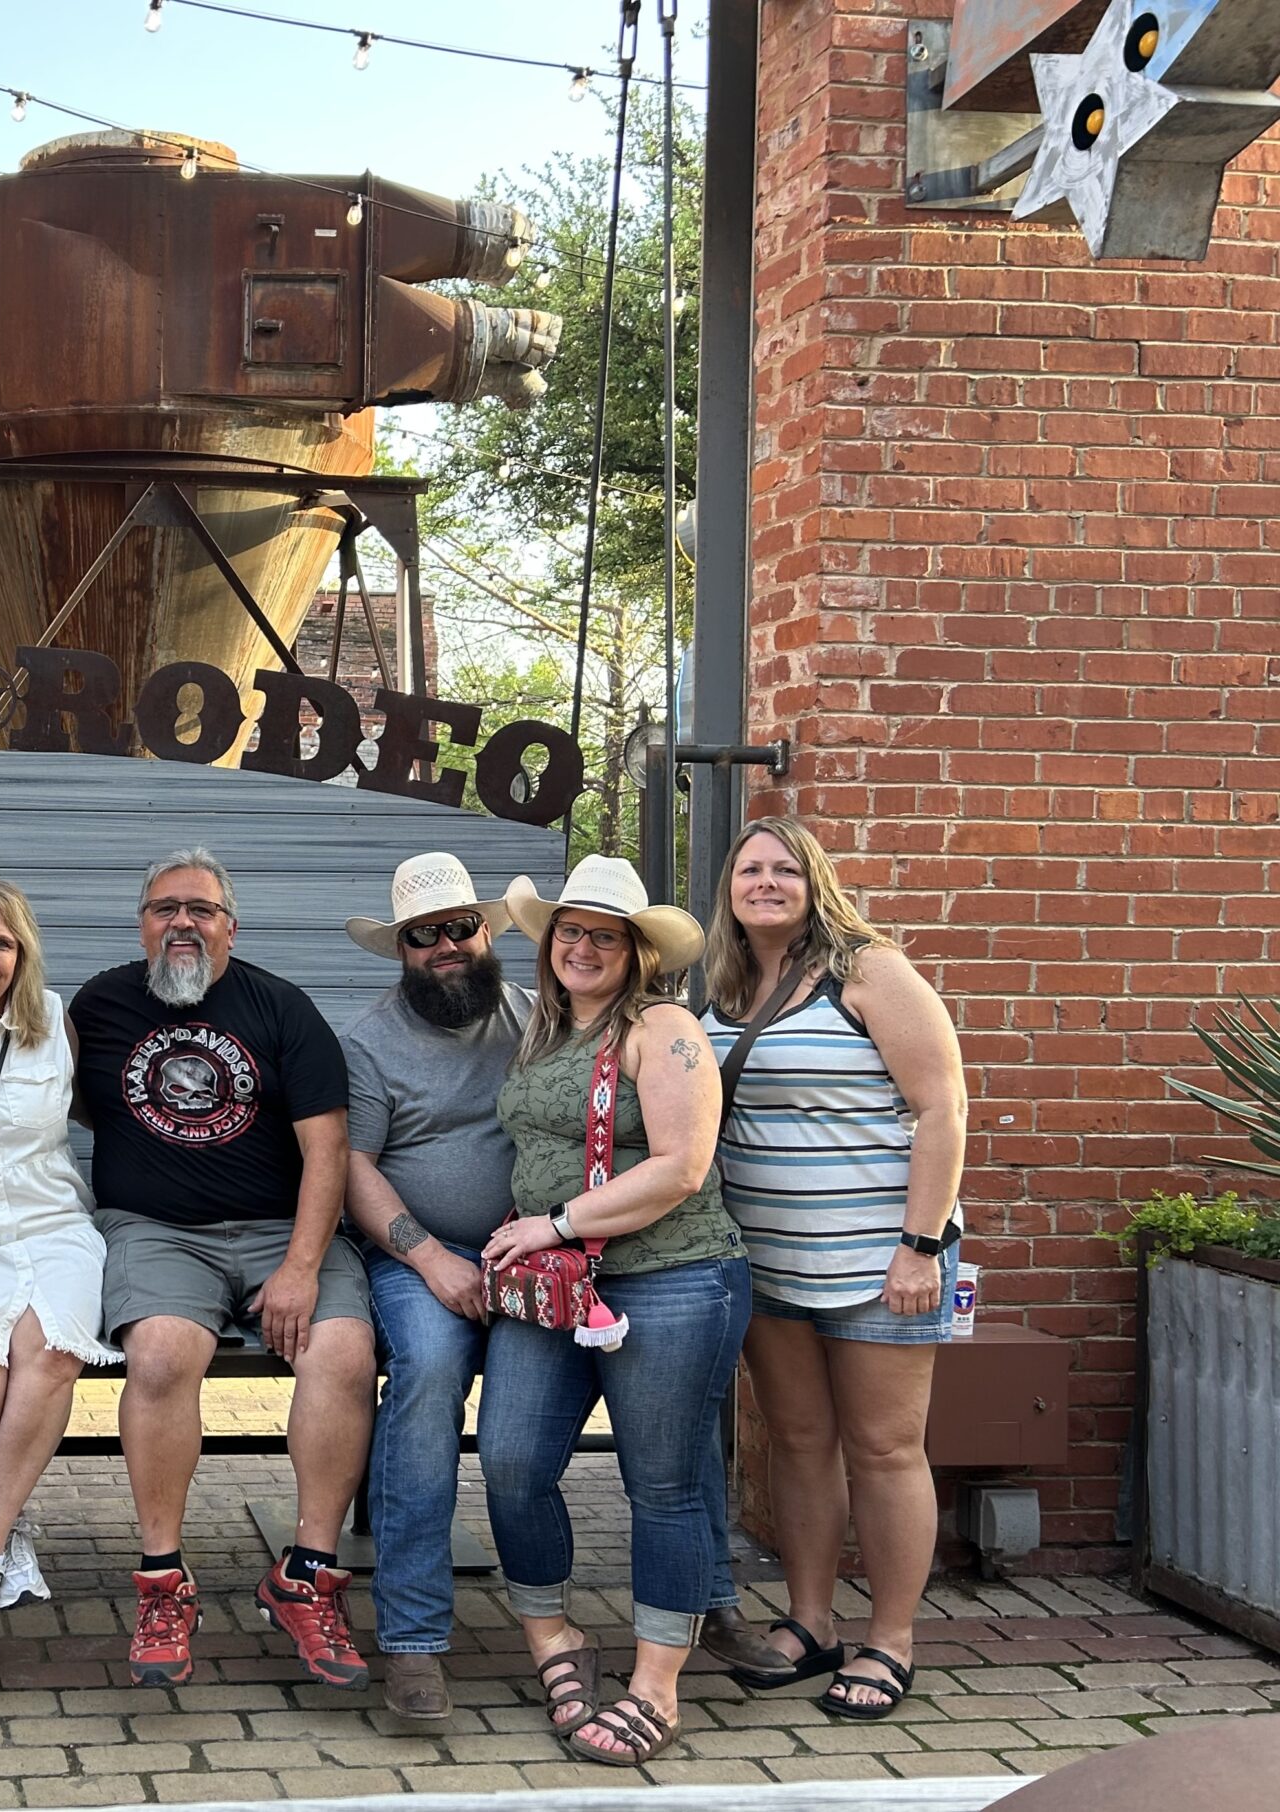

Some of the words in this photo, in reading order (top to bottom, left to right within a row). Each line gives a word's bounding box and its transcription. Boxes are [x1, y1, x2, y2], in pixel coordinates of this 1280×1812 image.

[10, 645, 584, 826] RODEO
[141, 1104, 175, 1132] SPEED
[178, 1125, 210, 1138] AND
